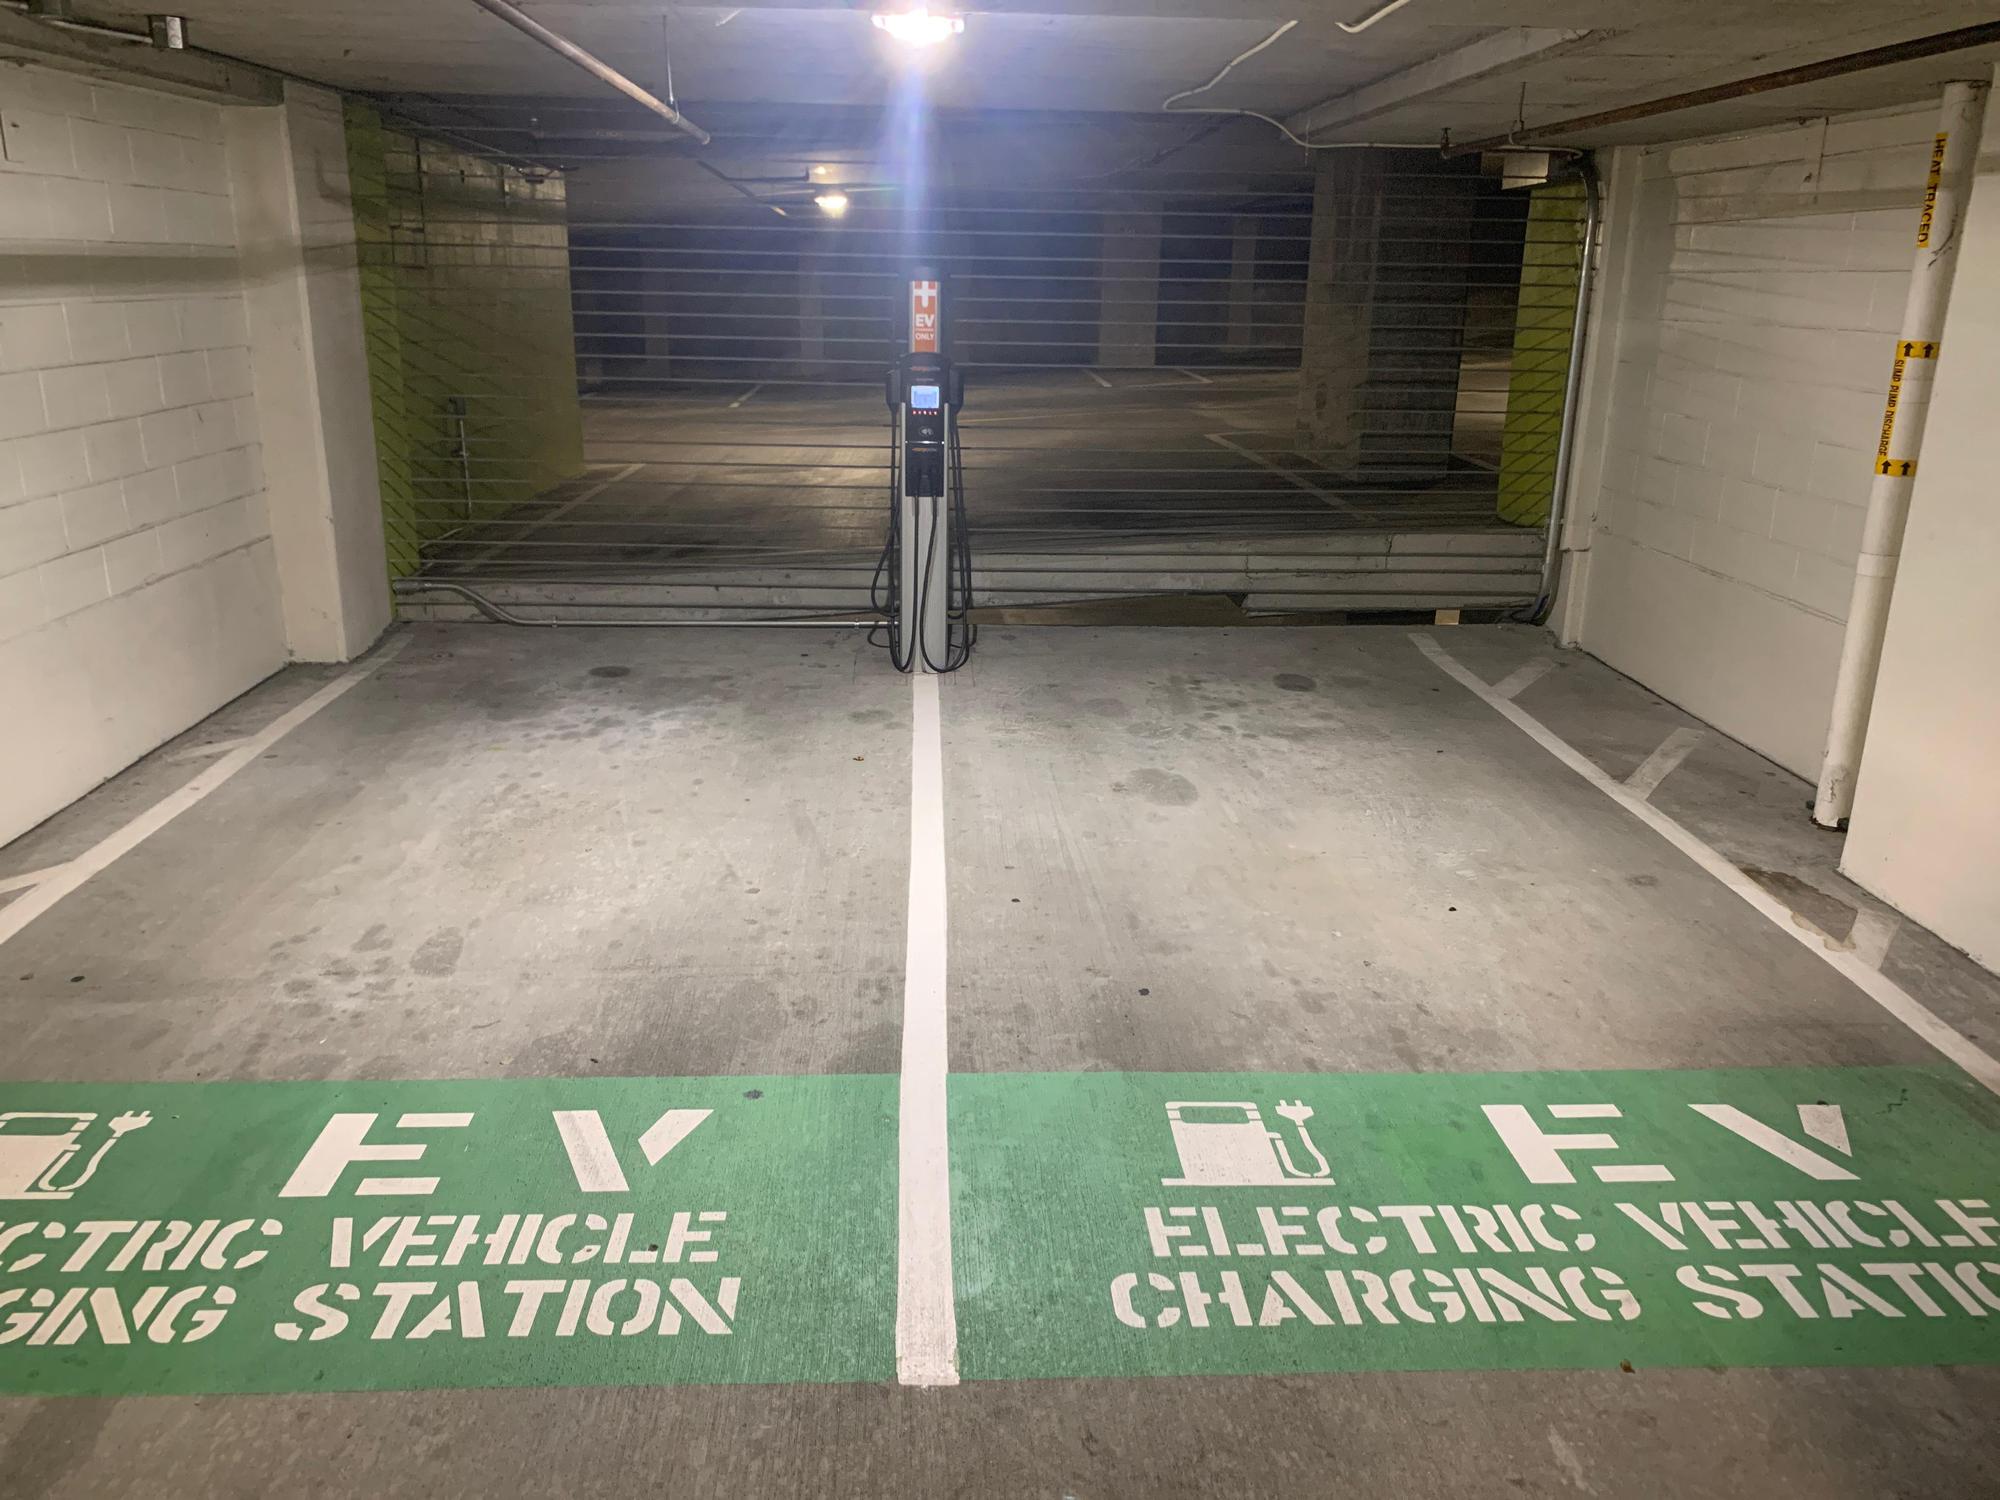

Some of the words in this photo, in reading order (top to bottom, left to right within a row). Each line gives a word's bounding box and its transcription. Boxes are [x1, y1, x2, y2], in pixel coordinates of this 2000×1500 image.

[1930, 138, 1946, 175] HEAT
[1918, 183, 1938, 243] TRACED
[915, 314, 935, 328] EV
[915, 333, 935, 341] ONLY
[1888, 384, 1899, 408] PUMP
[1892, 359, 1904, 383] SUMP
[1878, 410, 1894, 456] DISCHARGE
[278, 1109, 714, 1197] EV
[1480, 1103, 1861, 1184] EV
[0, 1219, 283, 1272] CTRIC
[330, 1211, 727, 1268] VEHICLE
[1144, 1203, 1596, 1257] ELECTRIC
[1614, 1199, 2000, 1250] VEHICLE
[274, 1277, 742, 1341] STATION
[1110, 1266, 1641, 1328] CHARGING
